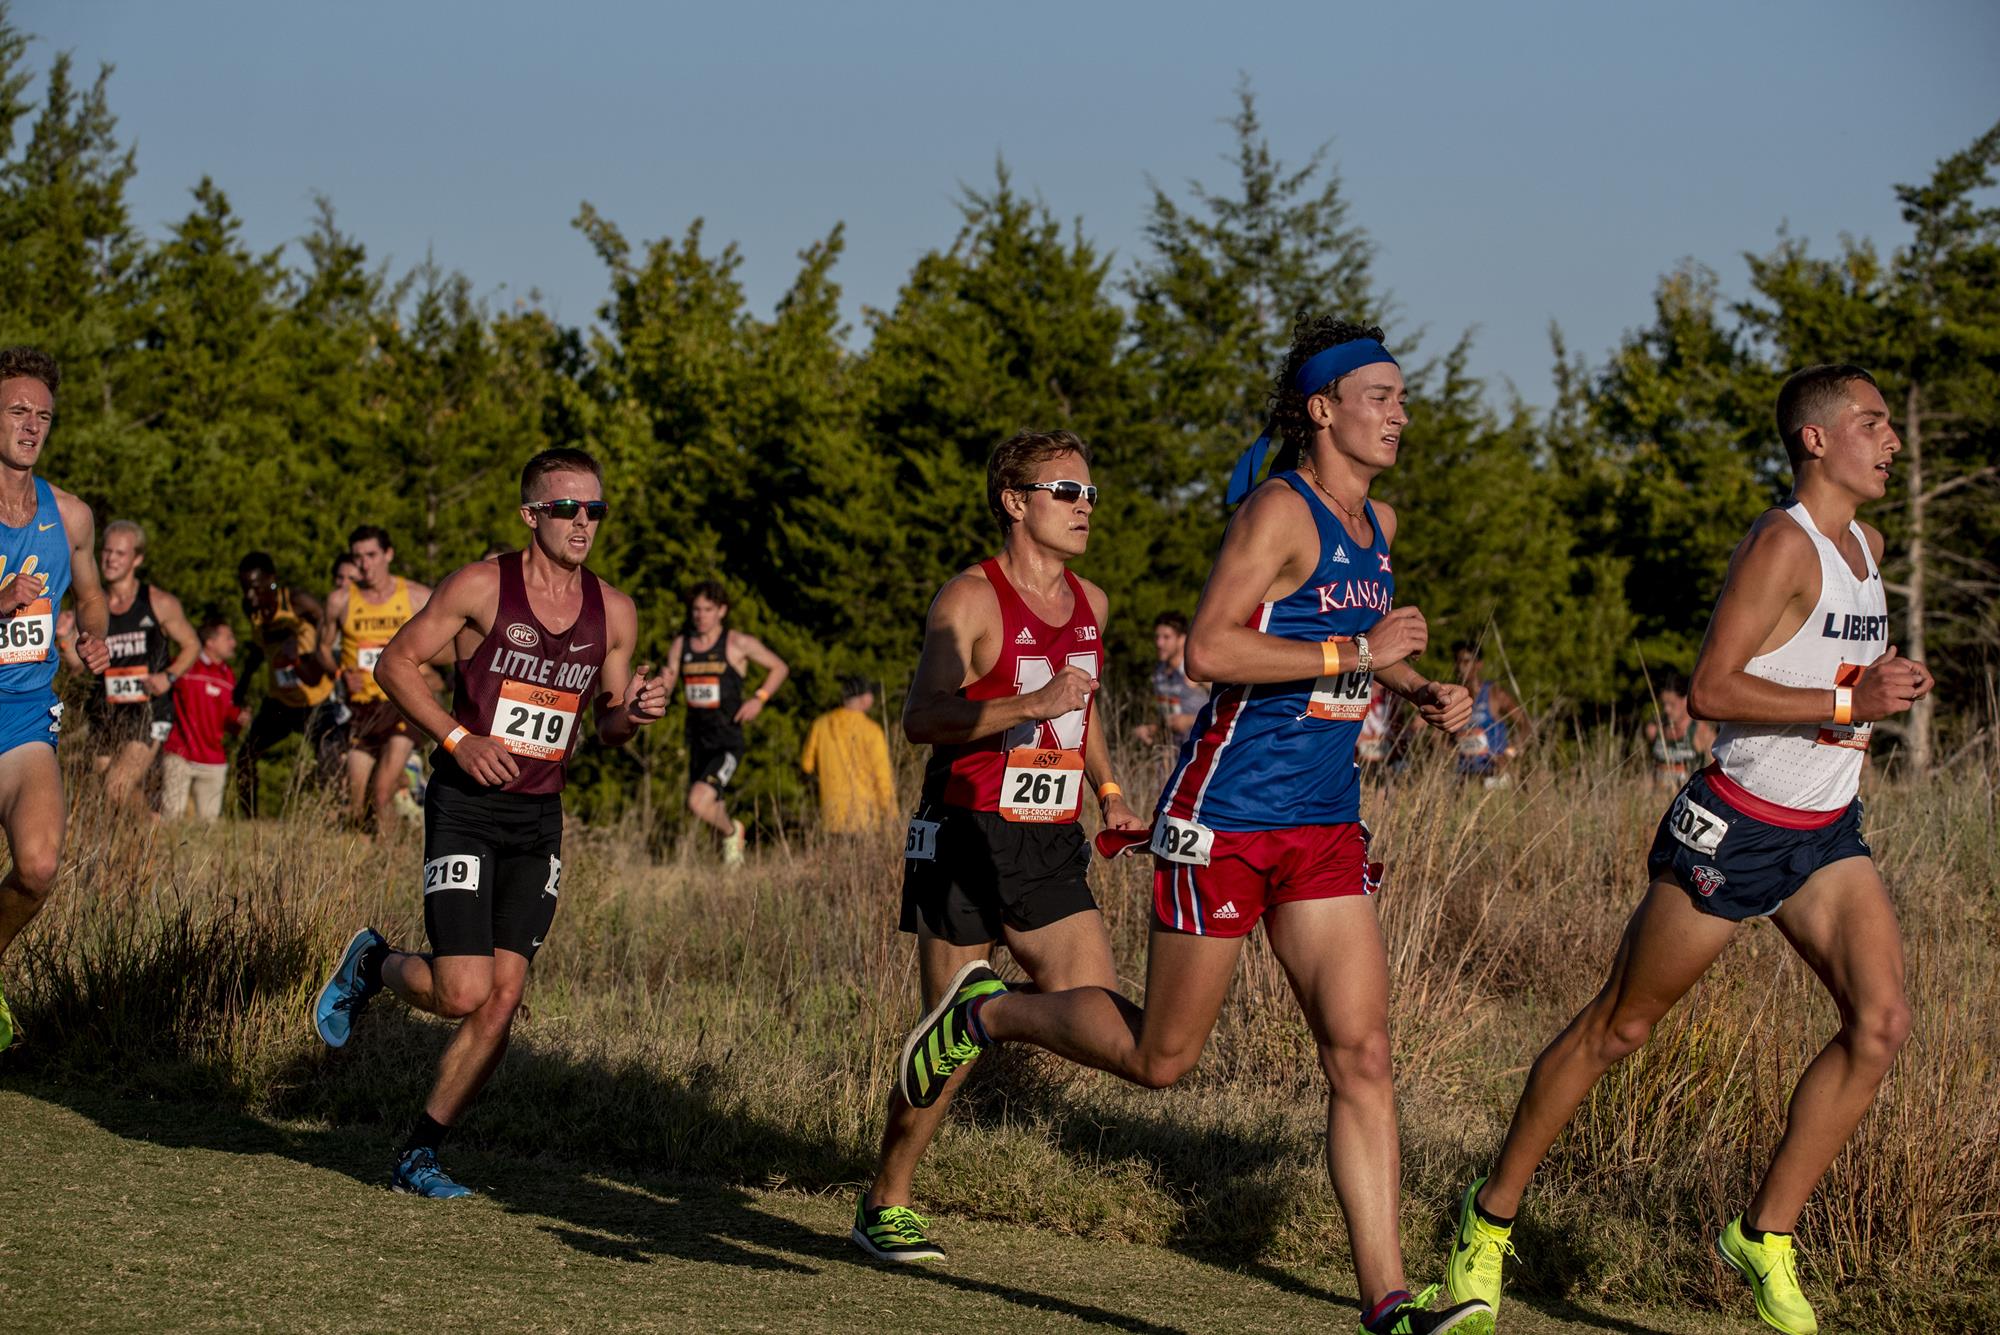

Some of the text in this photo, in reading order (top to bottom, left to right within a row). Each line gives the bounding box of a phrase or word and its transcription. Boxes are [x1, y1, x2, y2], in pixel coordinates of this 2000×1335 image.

[1333, 556, 1350, 565] adidas
[1316, 579, 1393, 615] KANSA
[512, 630, 532, 642] OVC
[0, 648, 46, 660] EIS-CROCKETT
[489, 647, 555, 685] LITTLE
[505, 707, 564, 744] 219
[503, 738, 556, 754] WEIS-CROCKETT
[512, 746, 546, 758] INVITATIONAL
[1033, 751, 1062, 768] OSU
[1013, 772, 1067, 805] 261
[1012, 808, 1065, 817] WEIS-CROCKETT
[907, 826, 926, 852] 61
[1159, 824, 1199, 858] 192
[426, 861, 468, 888] 219
